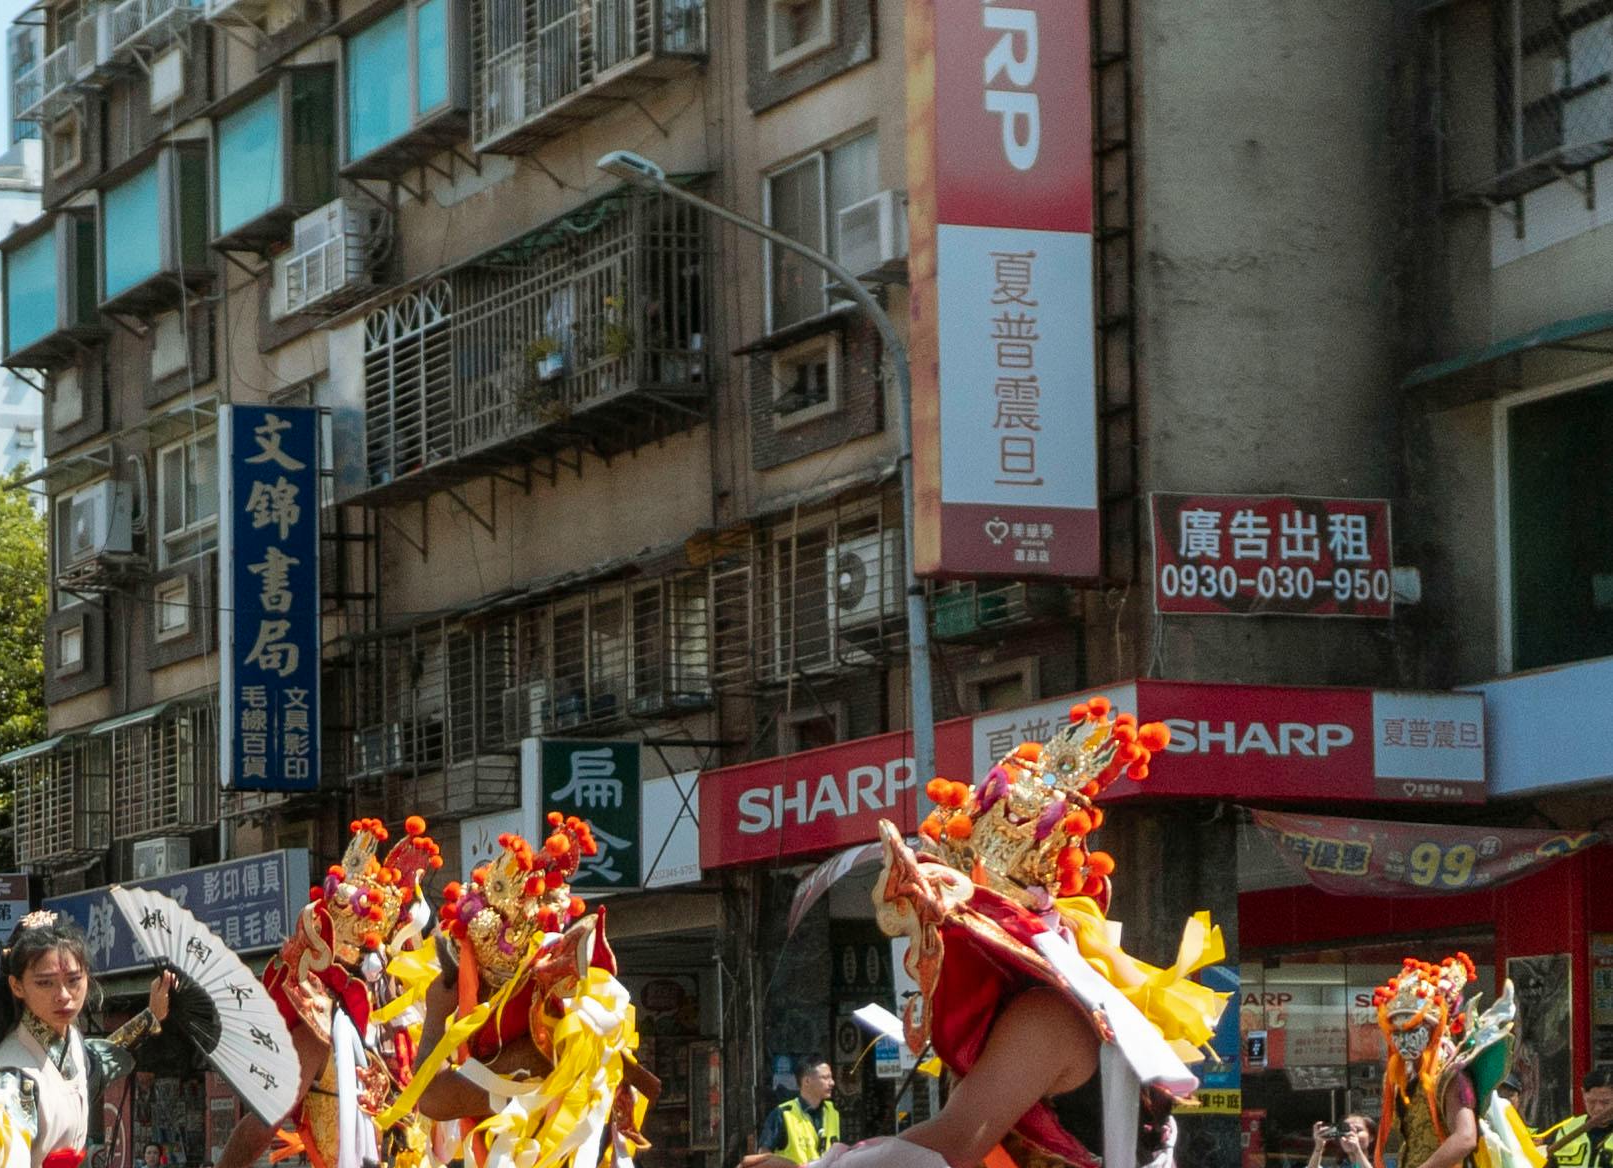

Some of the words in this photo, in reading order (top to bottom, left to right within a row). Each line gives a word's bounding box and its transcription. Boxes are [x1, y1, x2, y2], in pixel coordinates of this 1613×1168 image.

[989, 250, 1044, 487] 夏普震旦
[245, 413, 306, 678] 文錦書局
[1179, 508, 1372, 563] 廣告出租
[1161, 565, 1388, 603] 0930-030-950
[241, 685, 268, 780] 毛線百貨
[283, 685, 311, 780] 文具影印
[1163, 718, 1354, 757] SHARP
[1382, 717, 1482, 750] 夏普震旦
[737, 757, 917, 834] SHARP
[203, 860, 280, 905] 影印傳真
[1410, 842, 1476, 886] 99
[1243, 992, 1293, 1007] ARP
